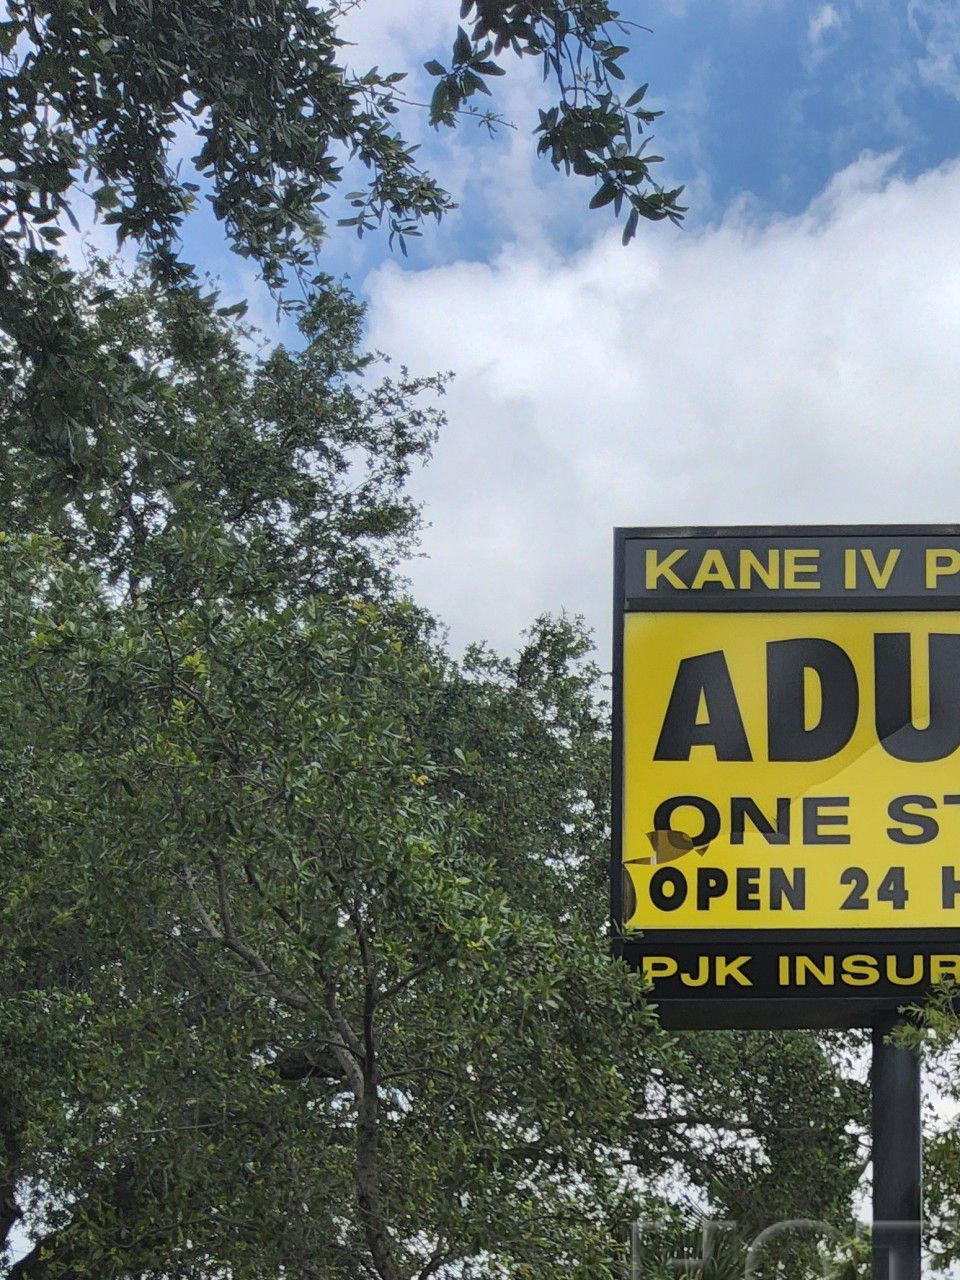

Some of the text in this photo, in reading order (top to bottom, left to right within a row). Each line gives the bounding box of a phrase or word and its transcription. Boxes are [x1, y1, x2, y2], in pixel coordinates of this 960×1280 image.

[645, 549, 821, 590] KANE
[845, 549, 900, 590] IV
[653, 795, 851, 847] ONE
[649, 866, 806, 911] OPEN
[839, 866, 909, 910] 24
[642, 955, 753, 987] PJK
